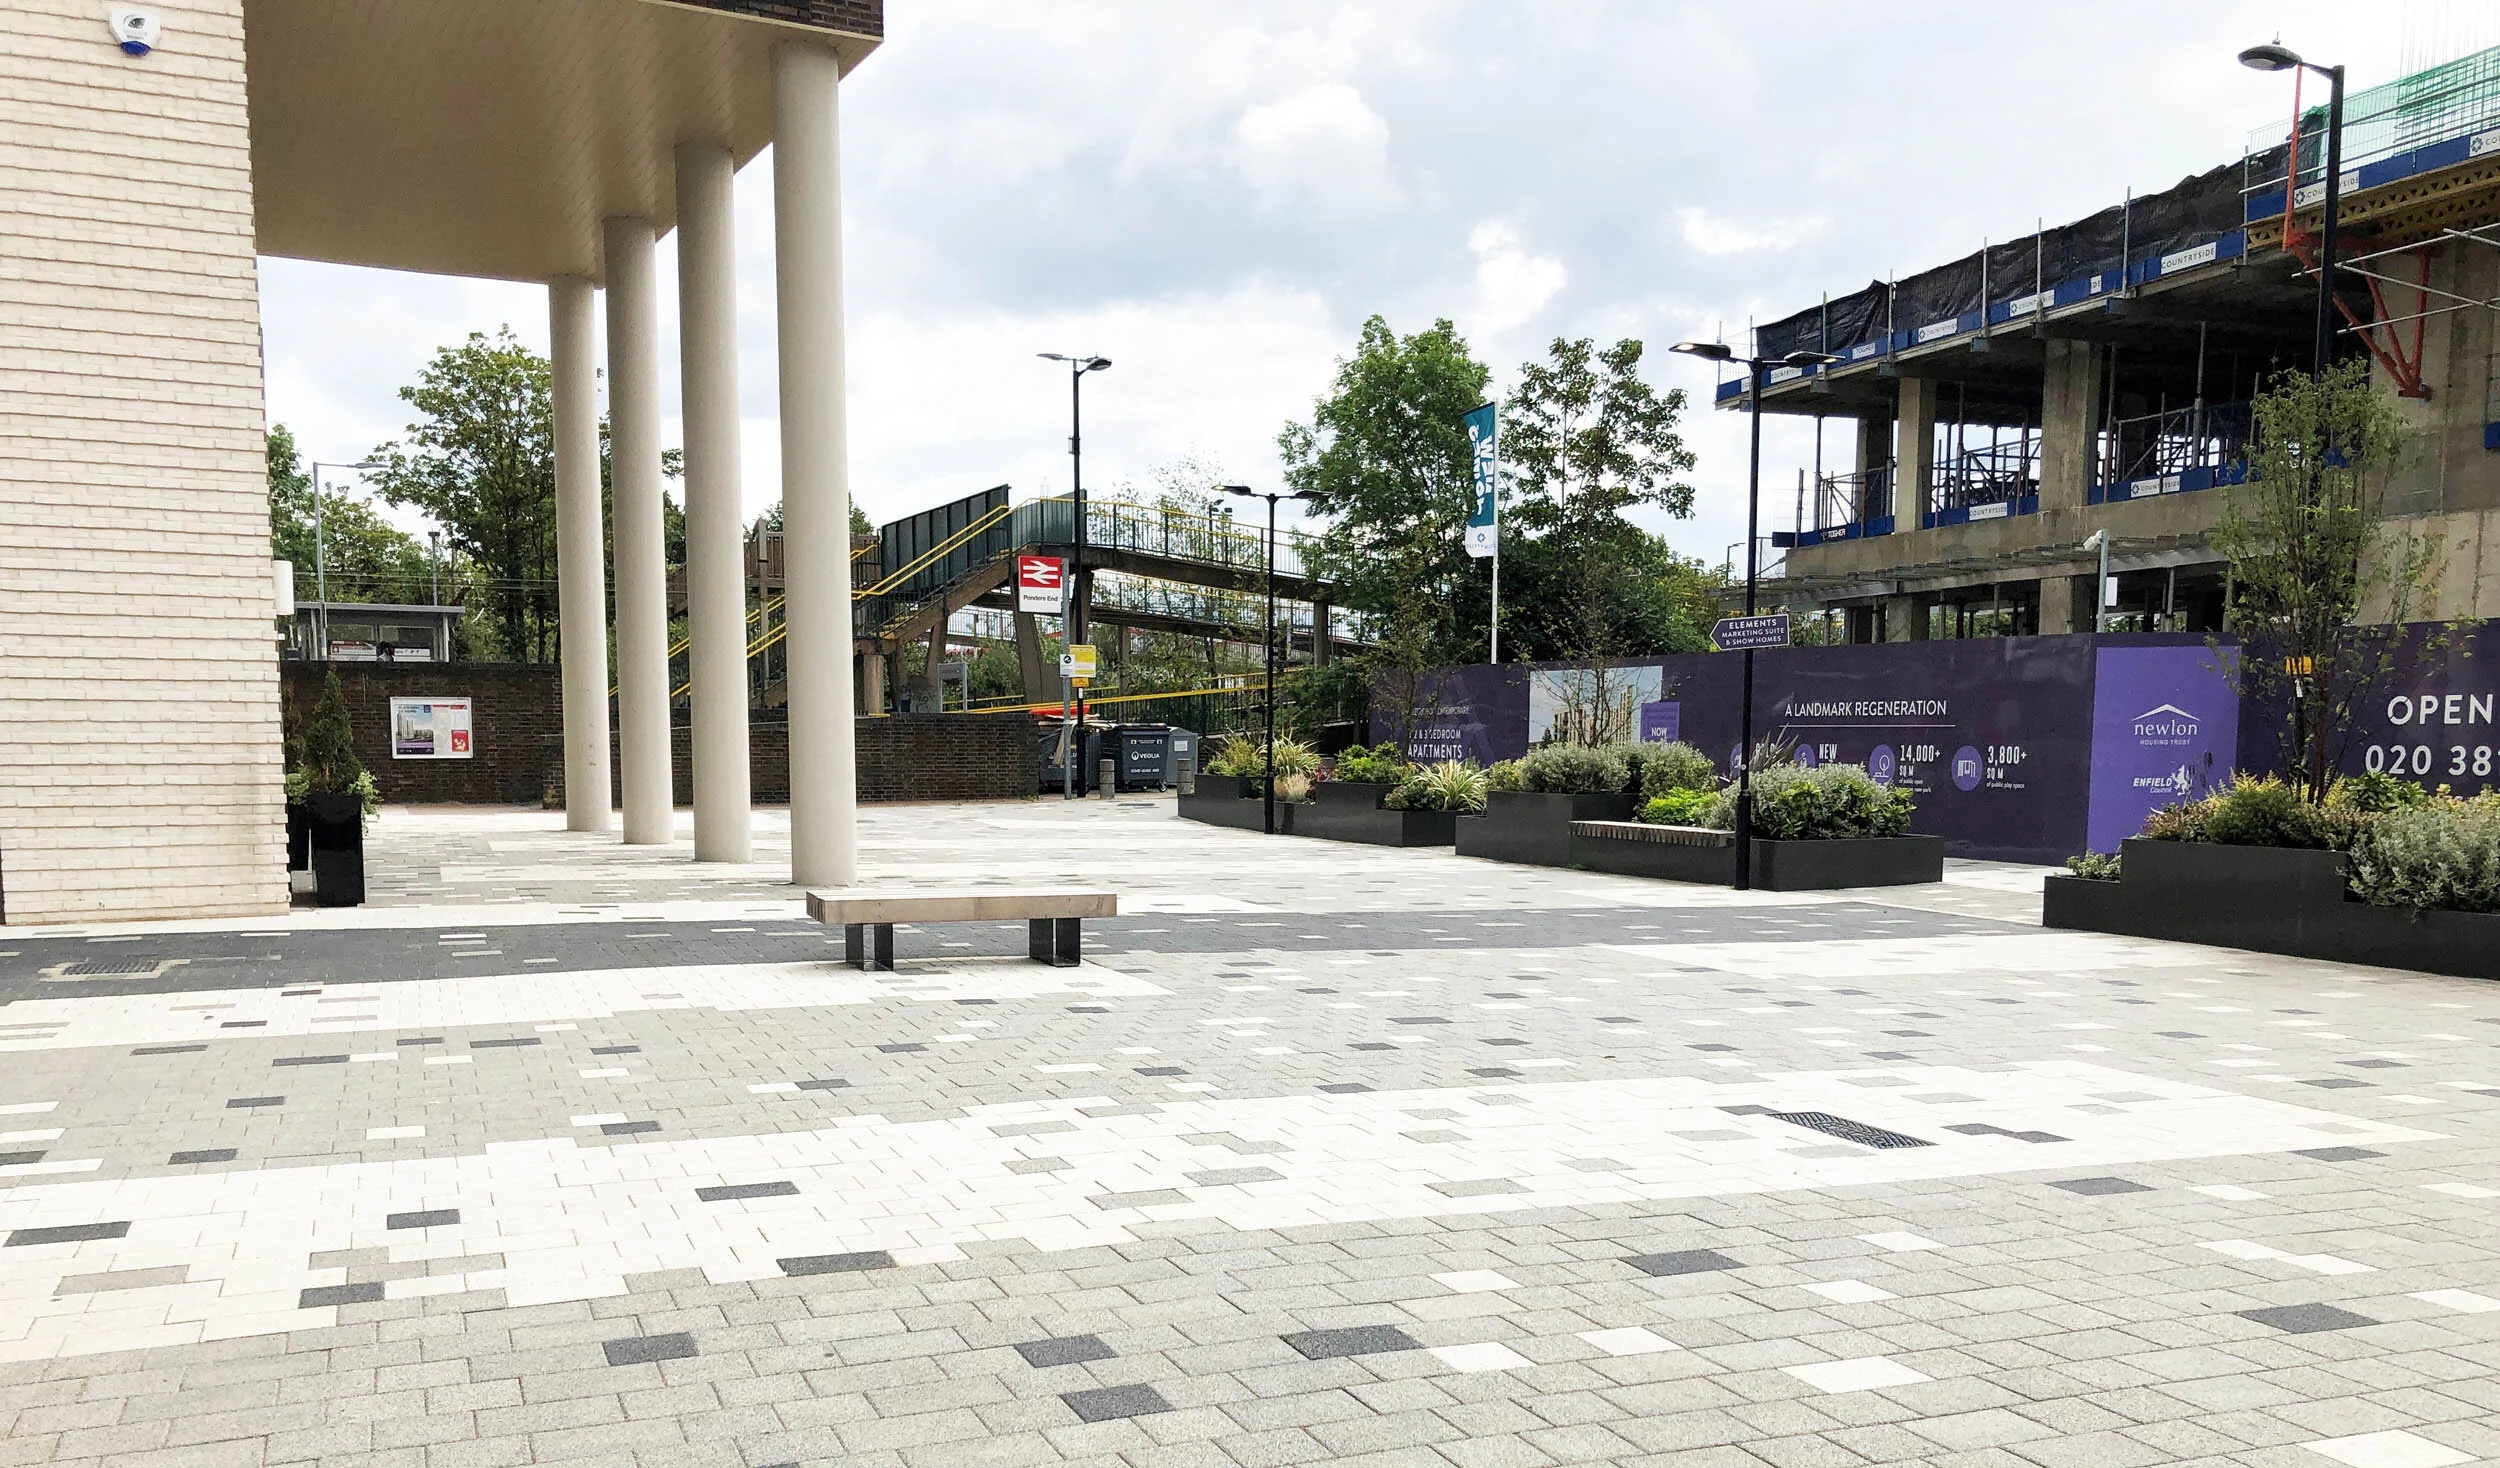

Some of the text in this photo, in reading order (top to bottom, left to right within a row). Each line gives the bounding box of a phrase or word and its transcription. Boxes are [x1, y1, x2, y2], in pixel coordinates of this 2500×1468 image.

[2161, 247, 2214, 269] COUNTRYSIDE
[1729, 619, 1777, 629] ELEMENTS
[1721, 627, 1784, 638] MARKETING SUITE
[1785, 700, 1947, 717] A LANDMARK REGENERATION
[2387, 694, 2493, 725] OPEN
[1651, 727, 1667, 736] NOW
[2134, 719, 2198, 736] newlon
[1819, 743, 1838, 759] NEW
[1900, 744, 1941, 764] 14,000+
[1987, 745, 2027, 766] 3,800+
[2365, 744, 2432, 776] 020
[1899, 765, 1914, 778] SQ M
[1986, 768, 2004, 781] SQ M
[2004, 782, 2012, 790] play
[2133, 777, 2173, 787] ENFIELD
[2150, 786, 2172, 794] Council
